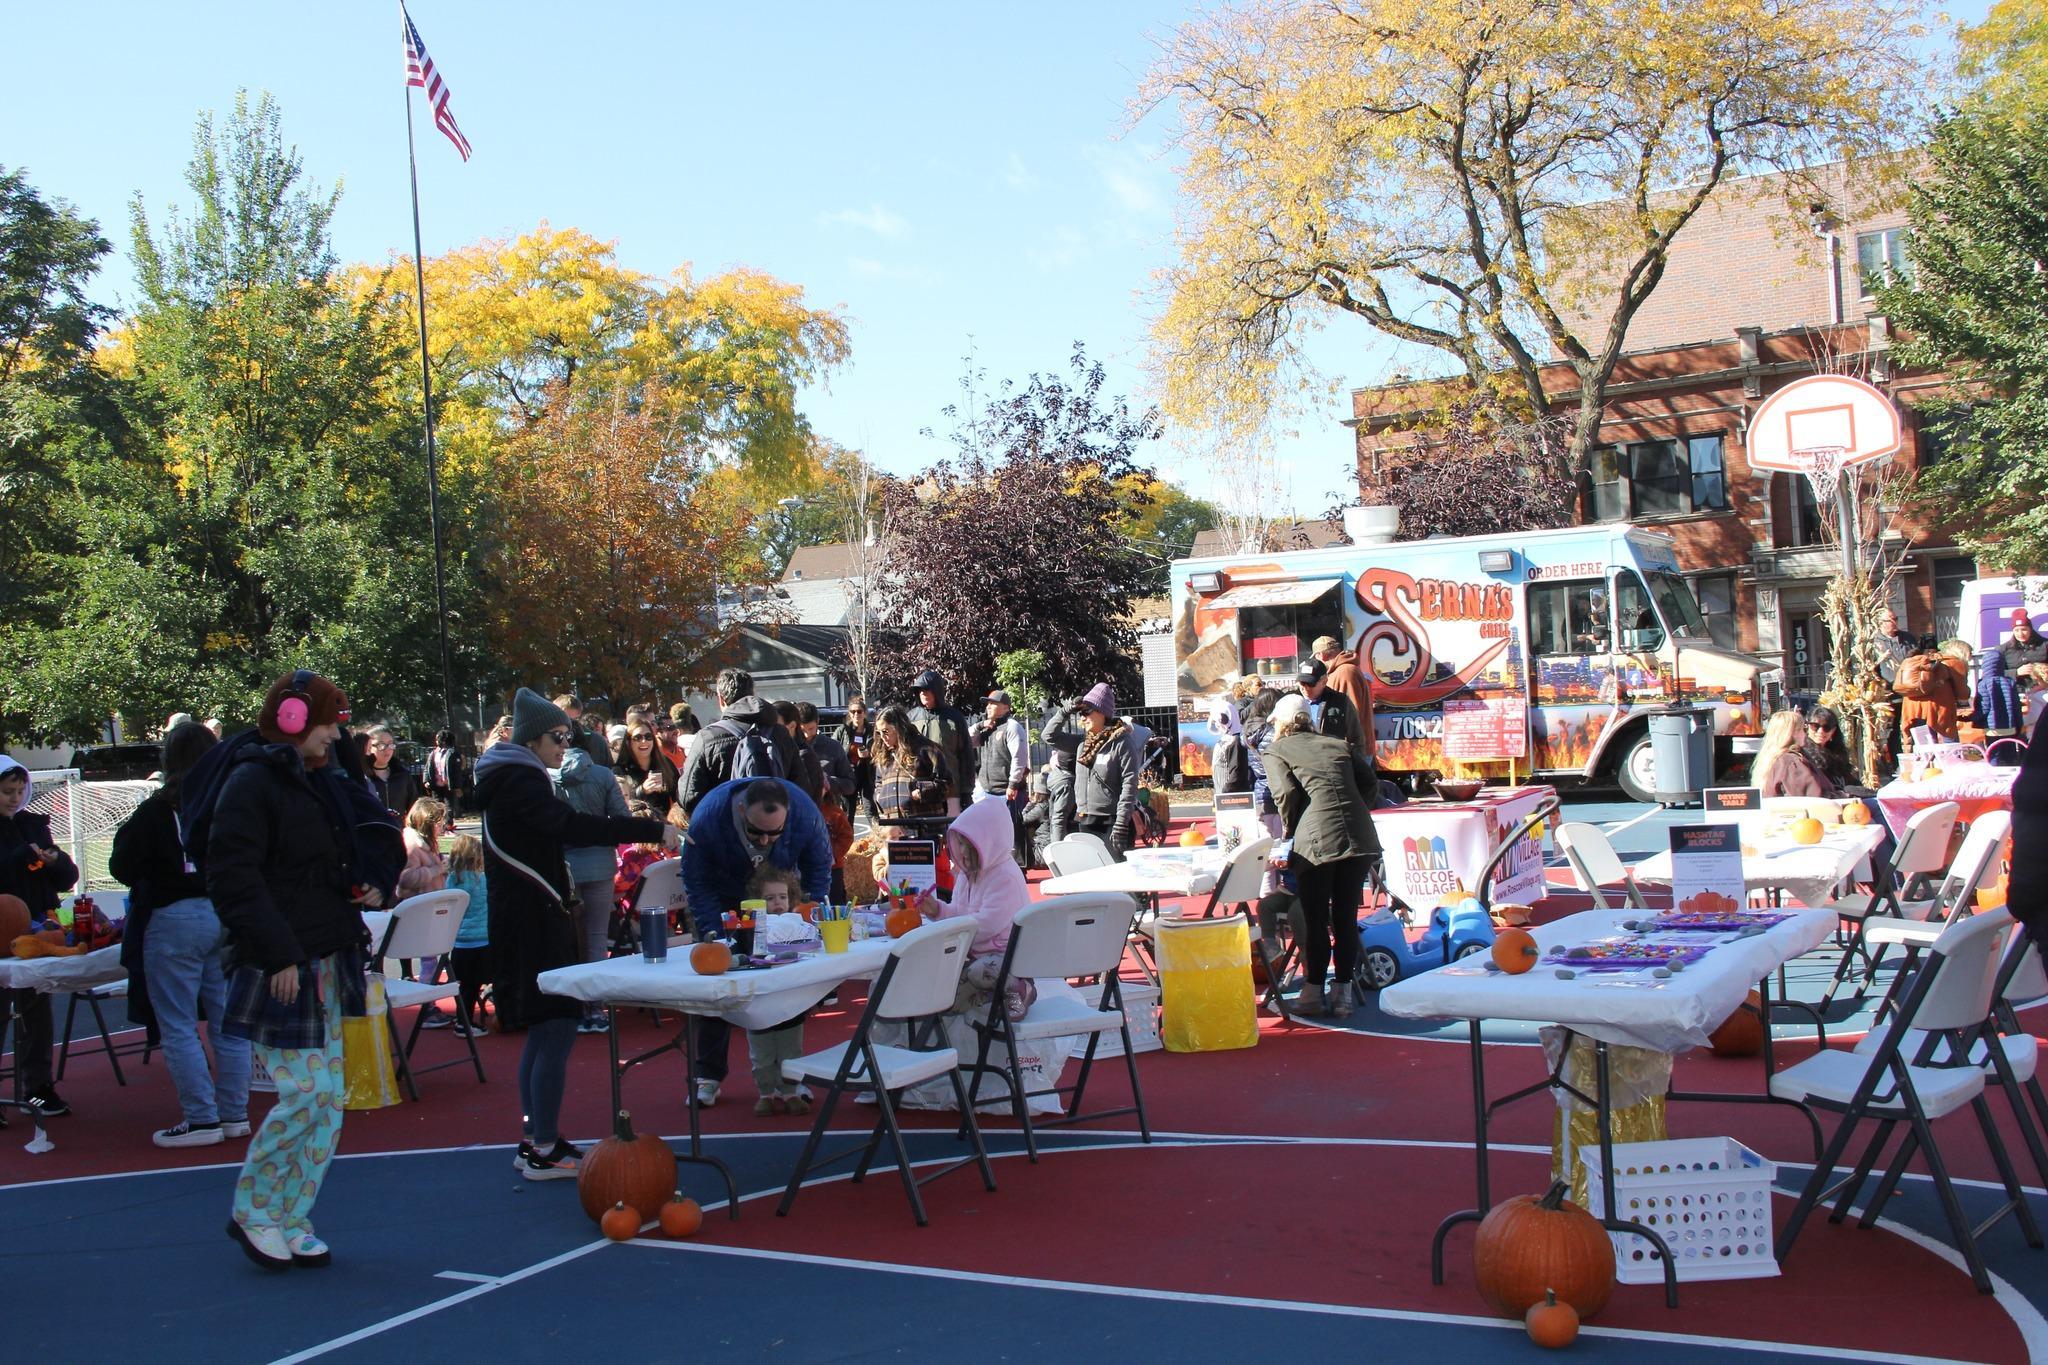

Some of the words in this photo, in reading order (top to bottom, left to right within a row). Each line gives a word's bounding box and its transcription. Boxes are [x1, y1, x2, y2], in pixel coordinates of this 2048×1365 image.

[1528, 564, 1569, 580] ORDER
[1571, 562, 1603, 577] HERE
[1479, 622, 1512, 639] GRILL
[1793, 626, 1809, 675] 1901
[1407, 850, 1447, 870] RVN
[1405, 870, 1455, 884] ROSCOE
[1406, 882, 1456, 896] VILLAGE
